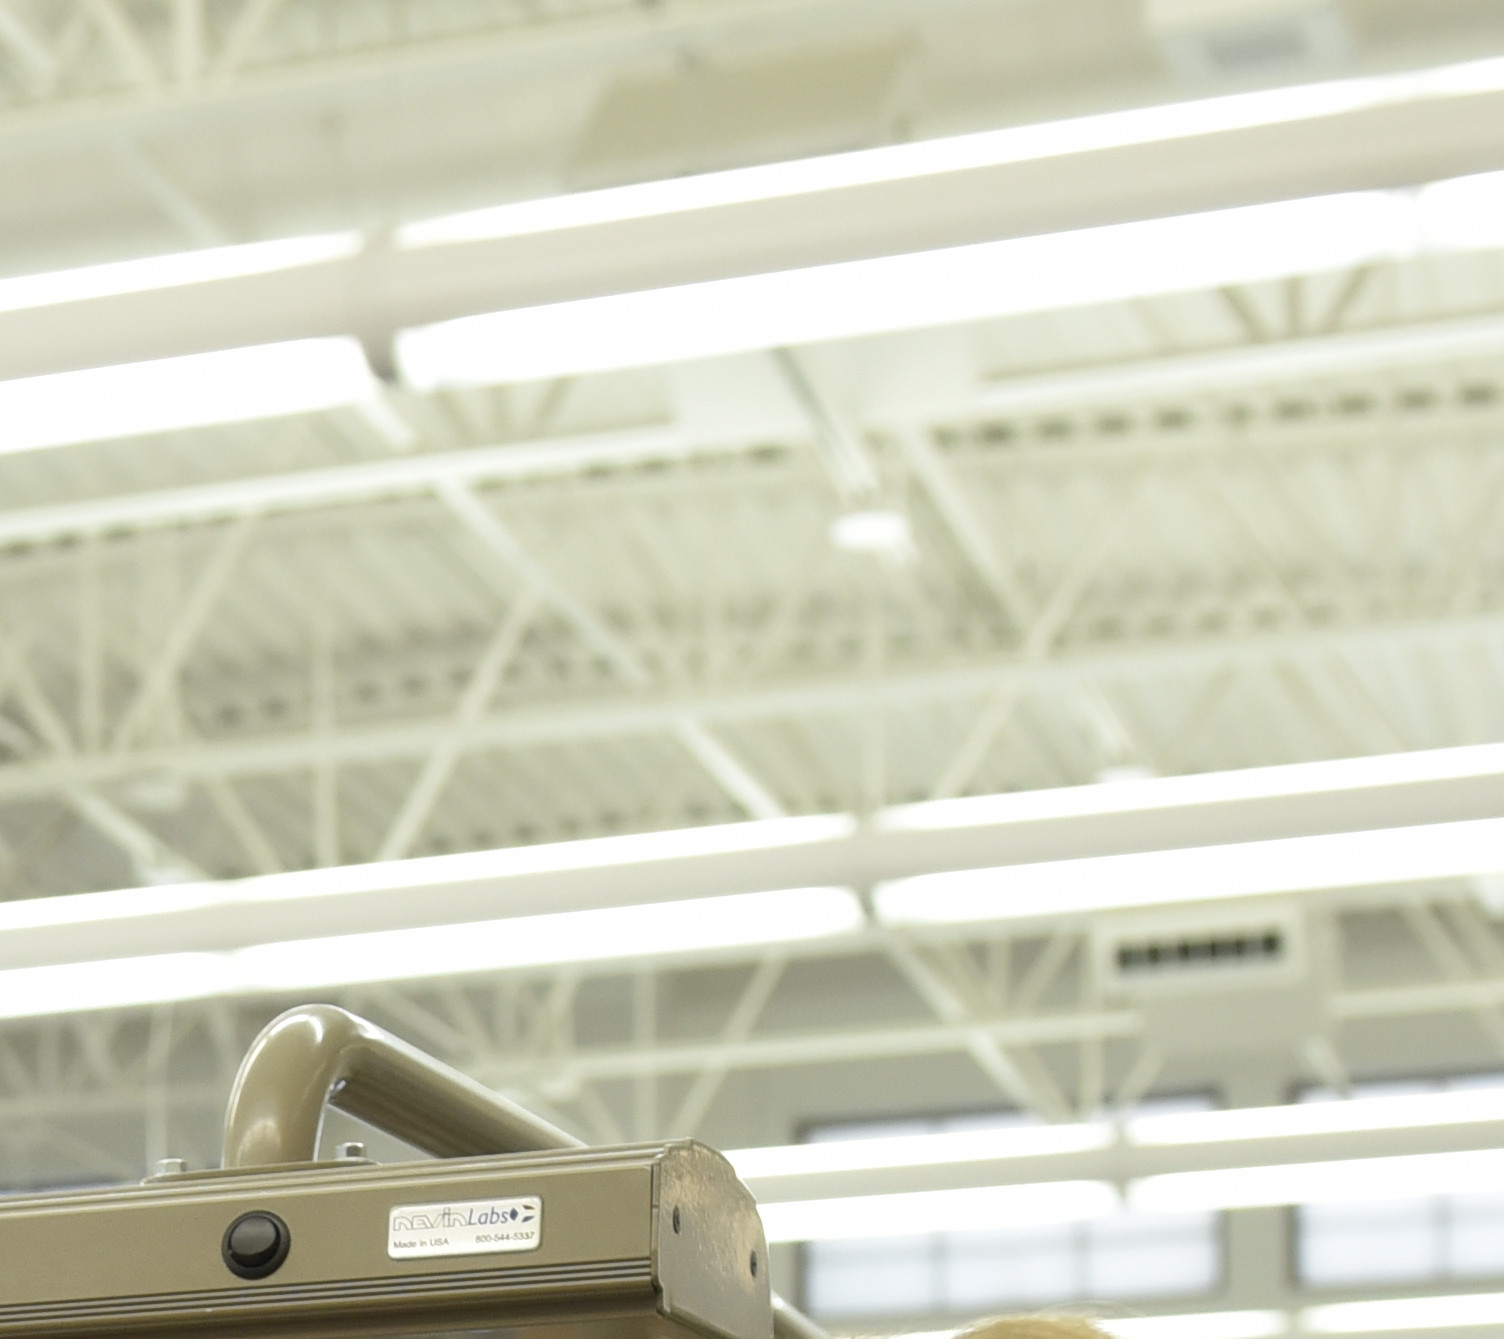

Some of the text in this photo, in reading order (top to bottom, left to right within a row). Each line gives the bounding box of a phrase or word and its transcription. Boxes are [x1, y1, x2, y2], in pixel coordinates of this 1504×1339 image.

[394, 1240, 417, 1248] Made
[420, 1239, 427, 1247] in
[430, 1238, 449, 1246] USA
